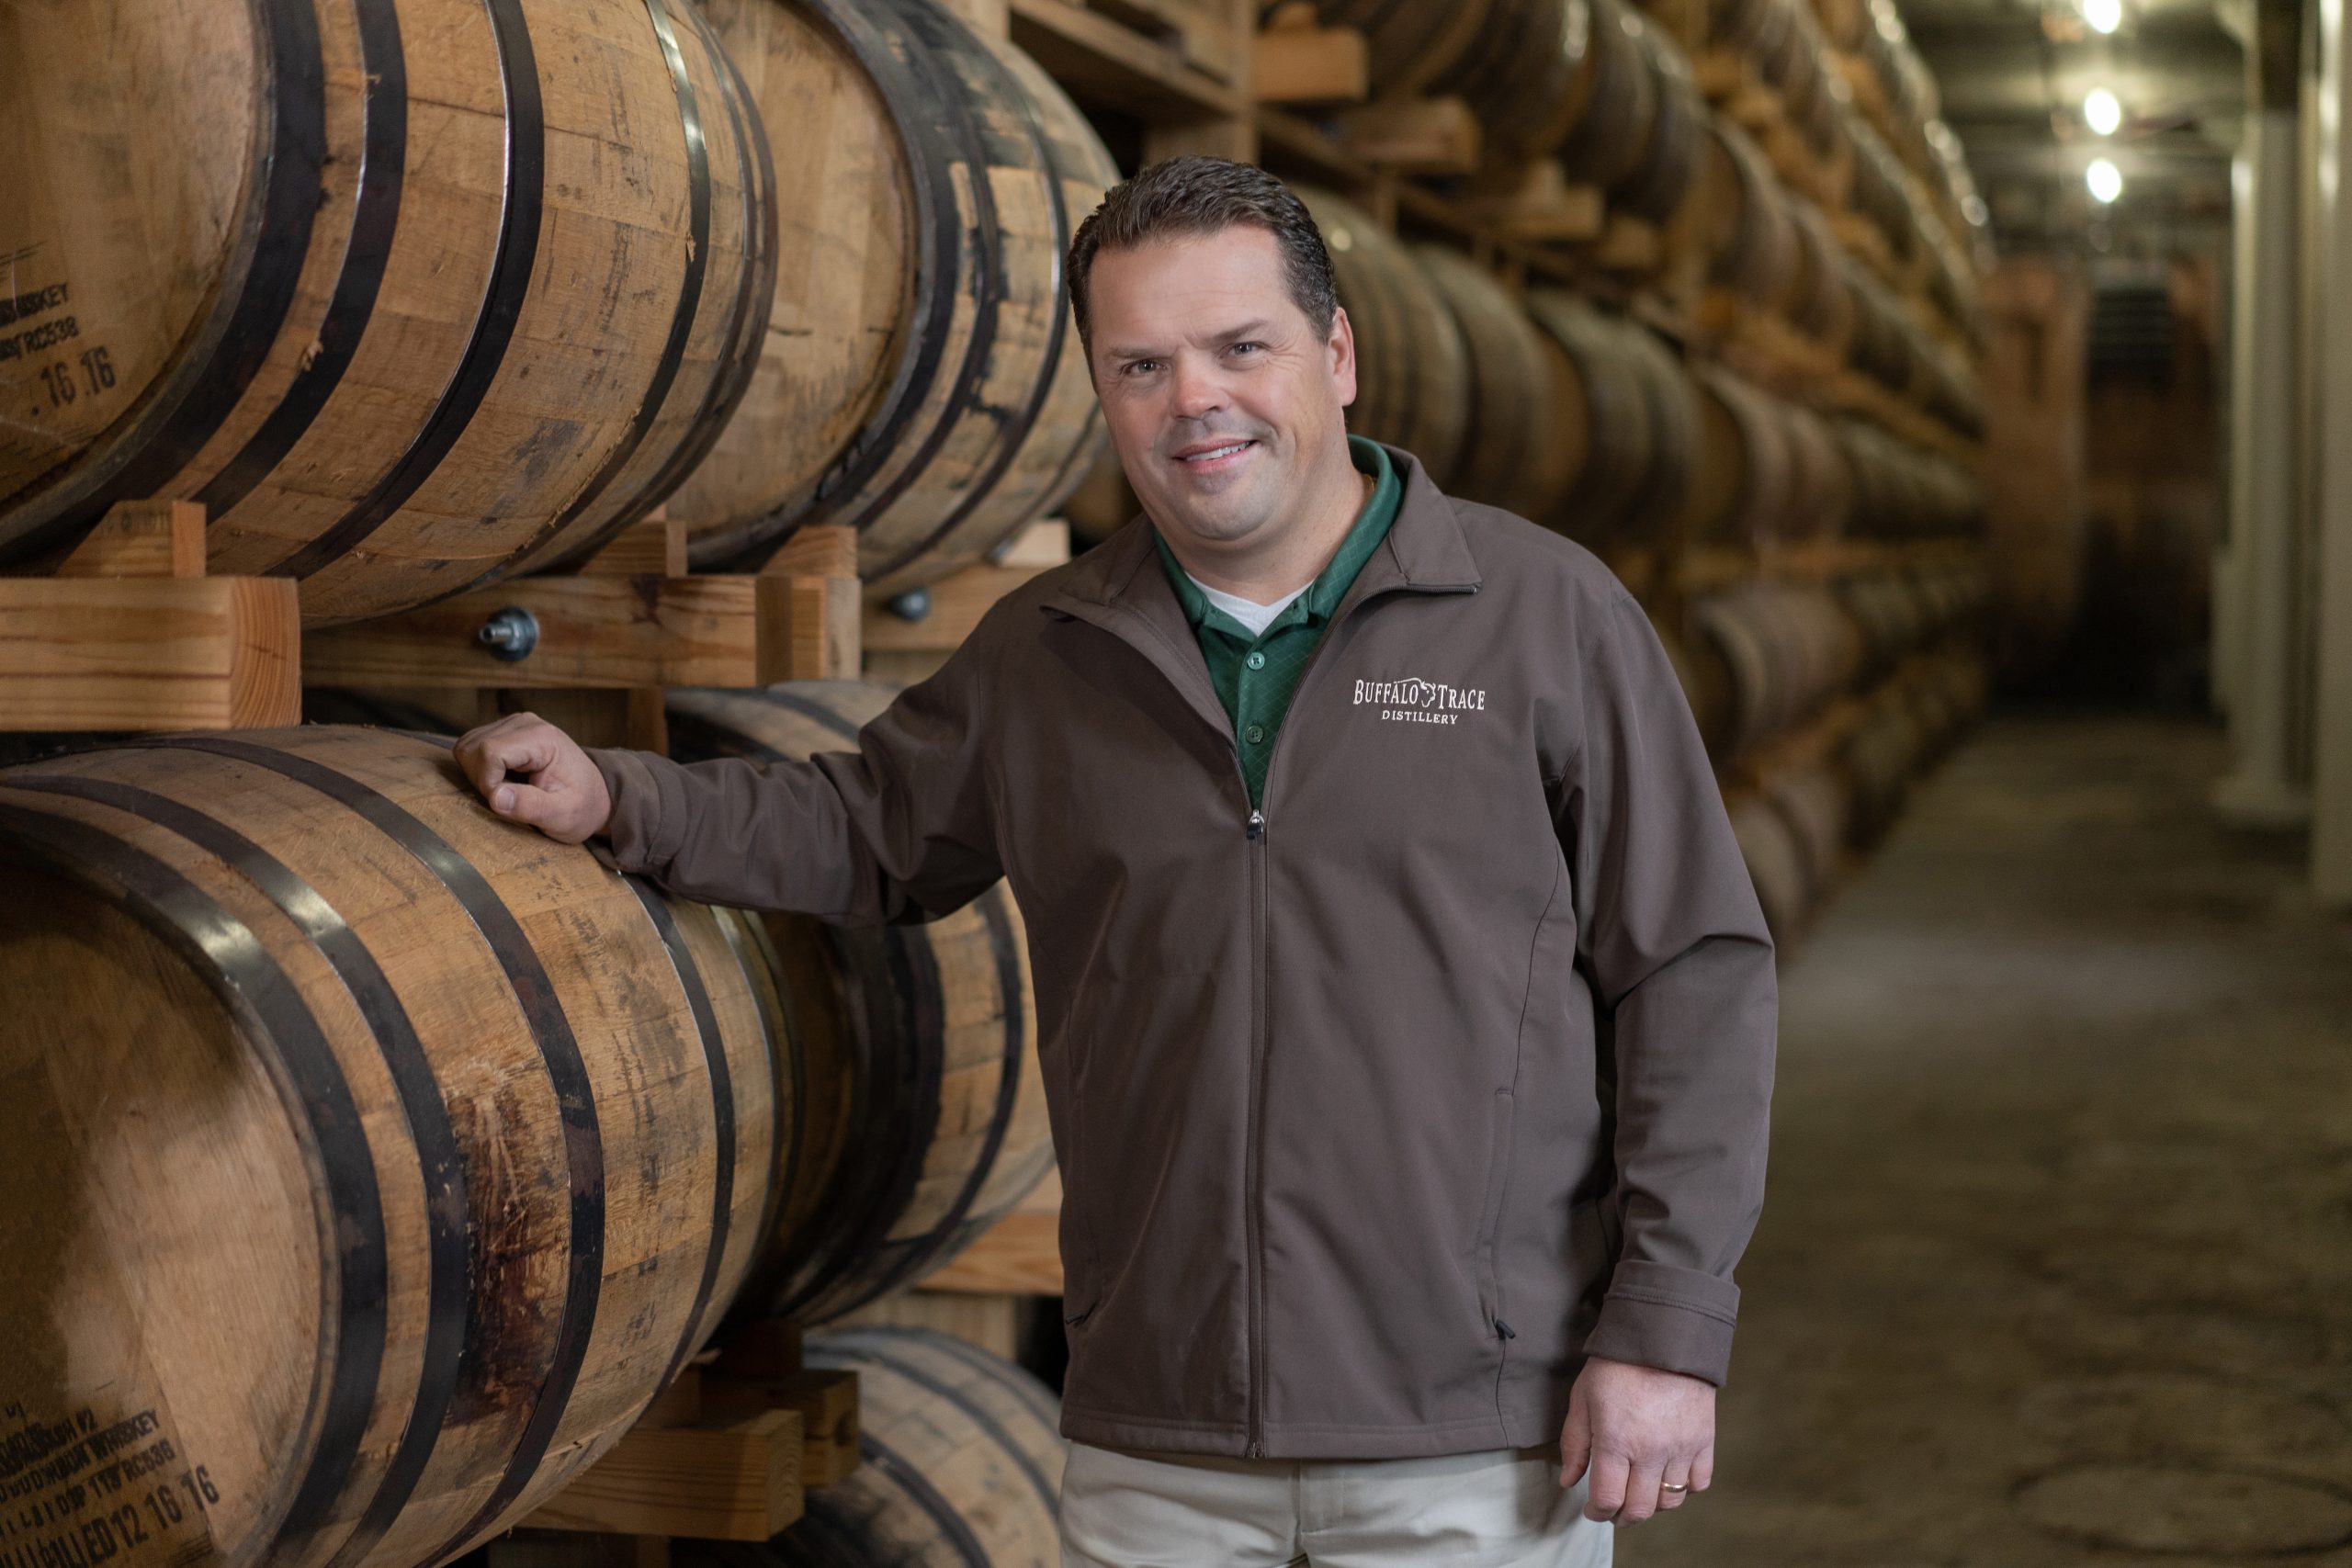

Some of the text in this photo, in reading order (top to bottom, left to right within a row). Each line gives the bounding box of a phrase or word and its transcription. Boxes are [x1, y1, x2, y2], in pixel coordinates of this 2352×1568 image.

[1353, 678, 1486, 711] BUFFALO TRACE
[1381, 709, 1459, 725] DISTILLERY
